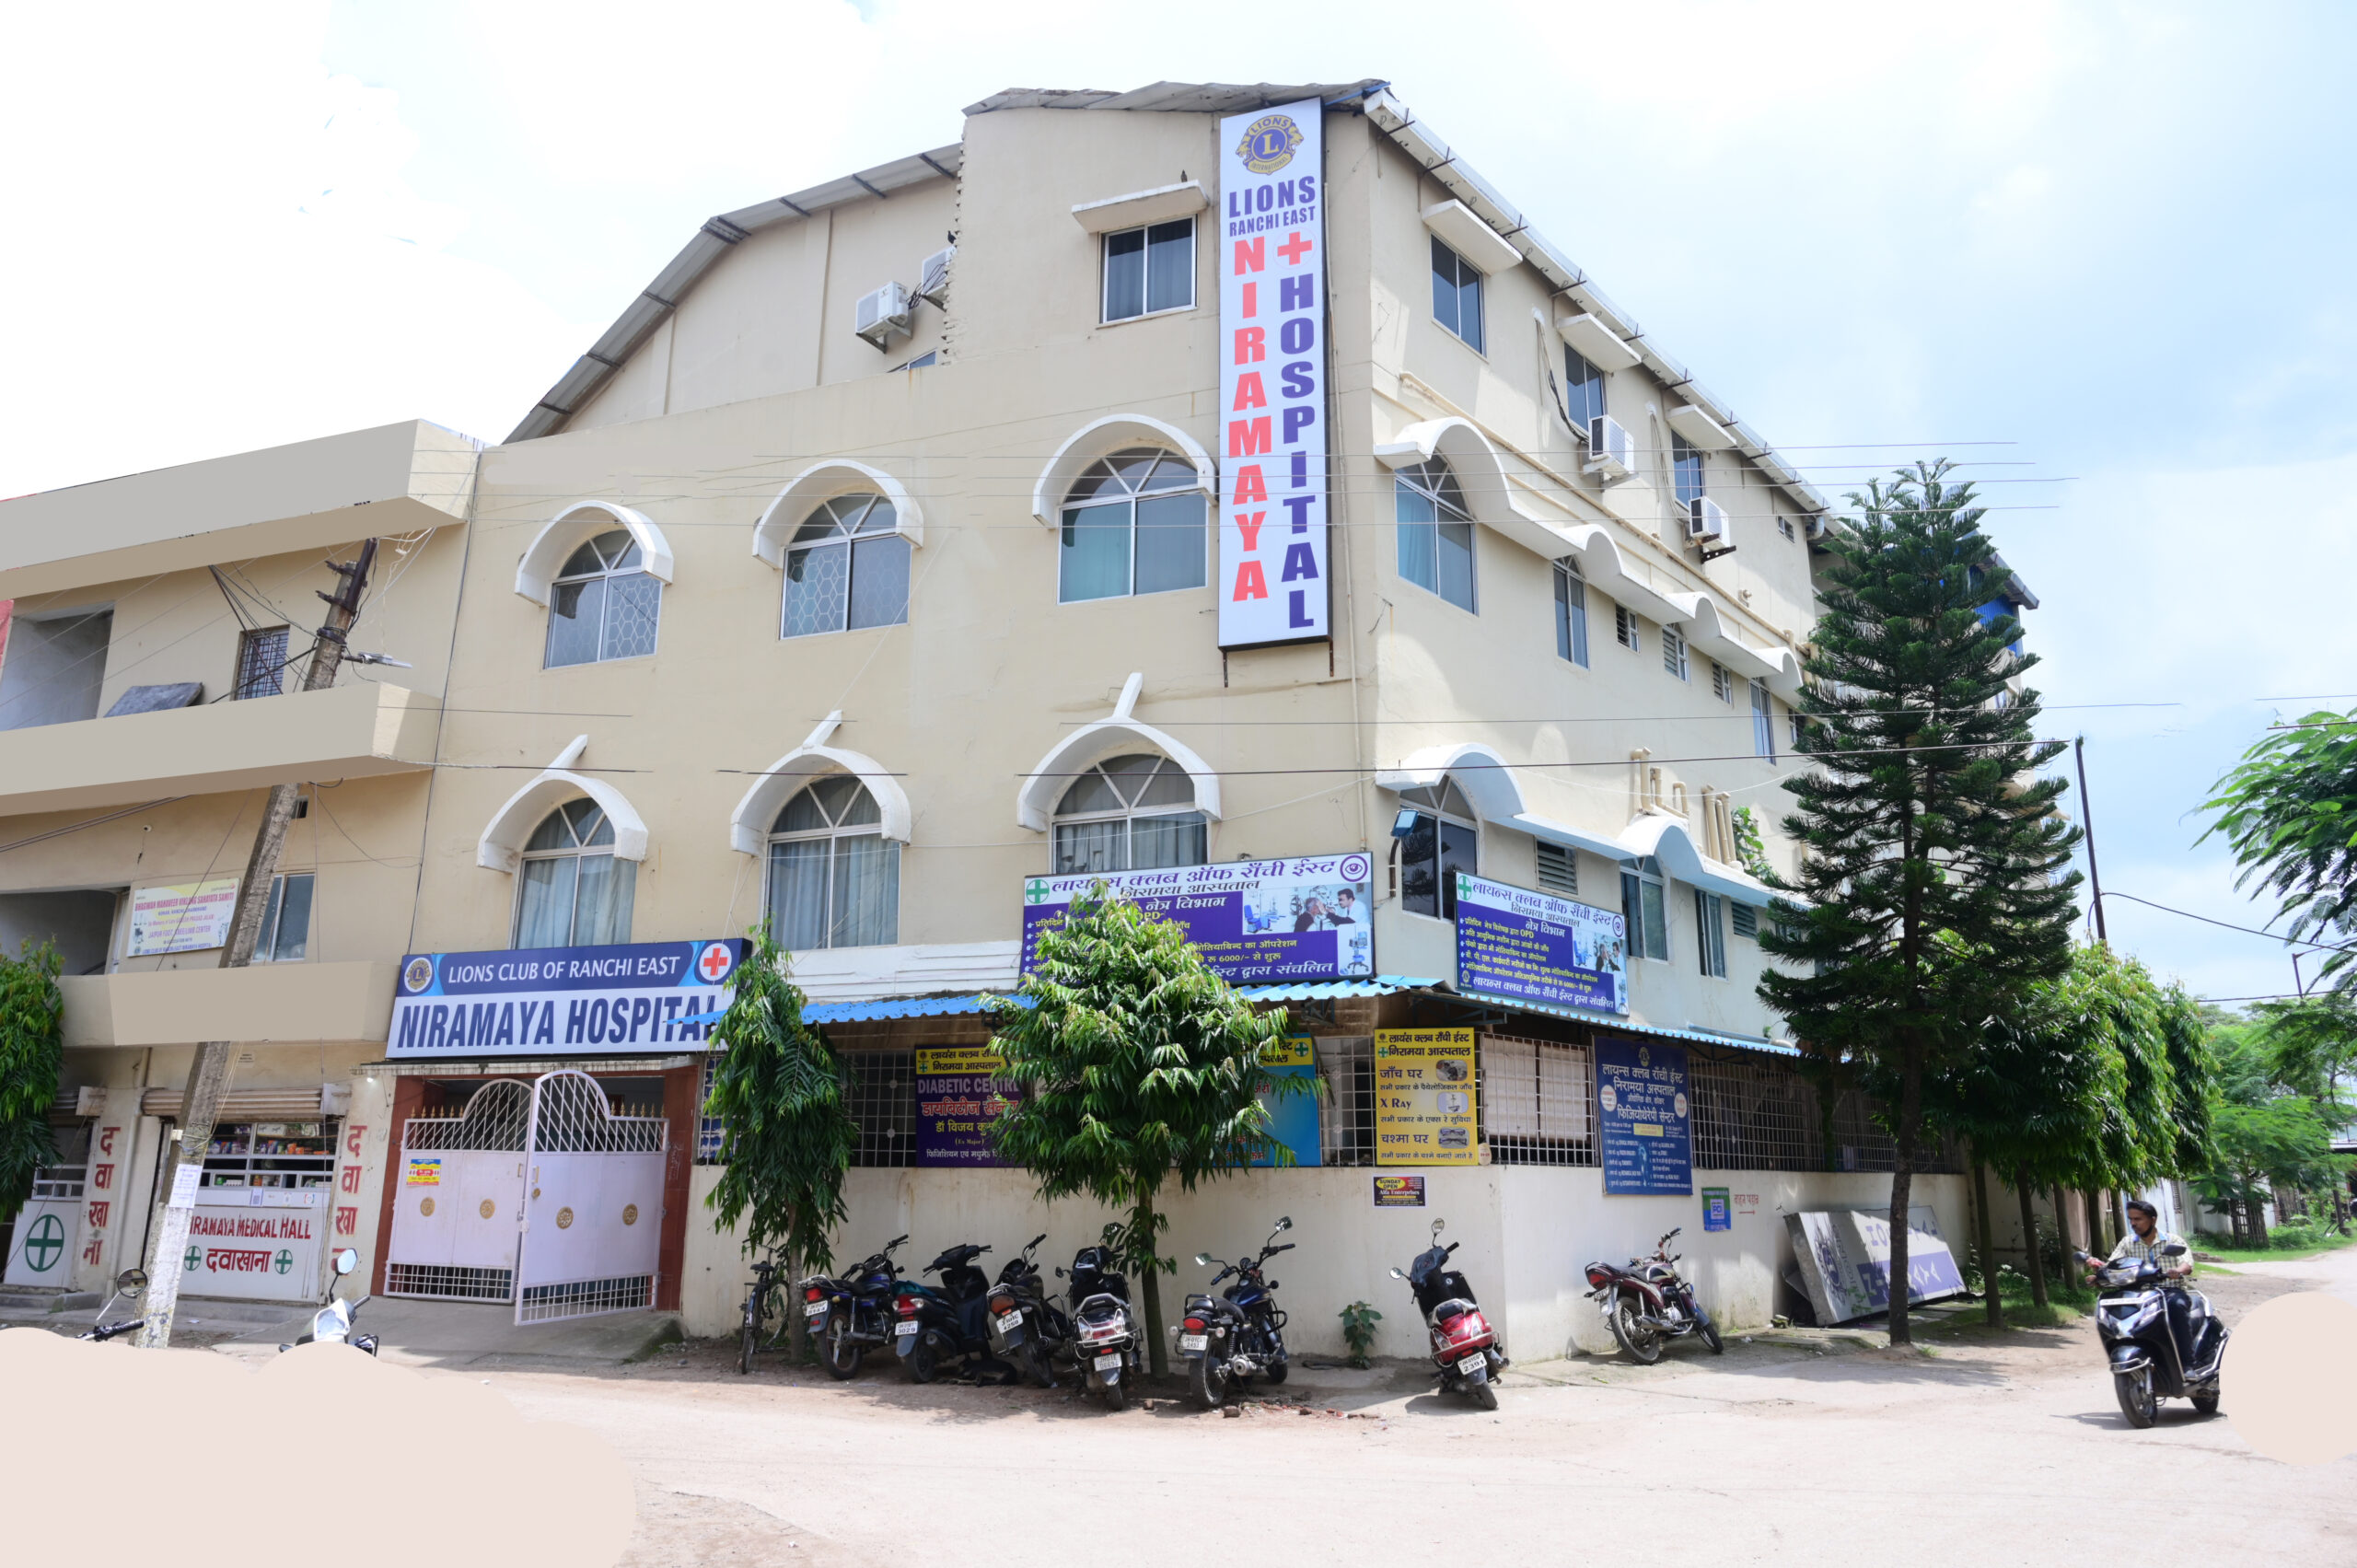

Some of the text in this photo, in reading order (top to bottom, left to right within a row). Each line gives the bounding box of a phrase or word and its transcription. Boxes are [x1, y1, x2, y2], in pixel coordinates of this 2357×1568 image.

[1250, 117, 1289, 134] LIONS
[1229, 176, 1316, 218] LIONS
[1229, 205, 1316, 237] RANCHI EAST
[1228, 236, 1271, 601] NIRAMAYA
[1281, 273, 1318, 629] HOSPITAL
[1292, 858, 1337, 877] ईस्ट
[1176, 896, 1227, 909] विभाग
[448, 956, 680, 984] LIONS CLUB OF RANCHI EAST
[397, 1000, 554, 1049] NIRAMAYA
[1407, 1068, 1422, 1078] घर
[917, 1078, 971, 1094] DIABETIC
[1380, 1098, 1388, 1108] X
[1413, 1134, 1429, 1144] घर
[190, 1215, 311, 1239] IRAMAYA MEDICAL HALL
[206, 1249, 273, 1273] दवाखाना
